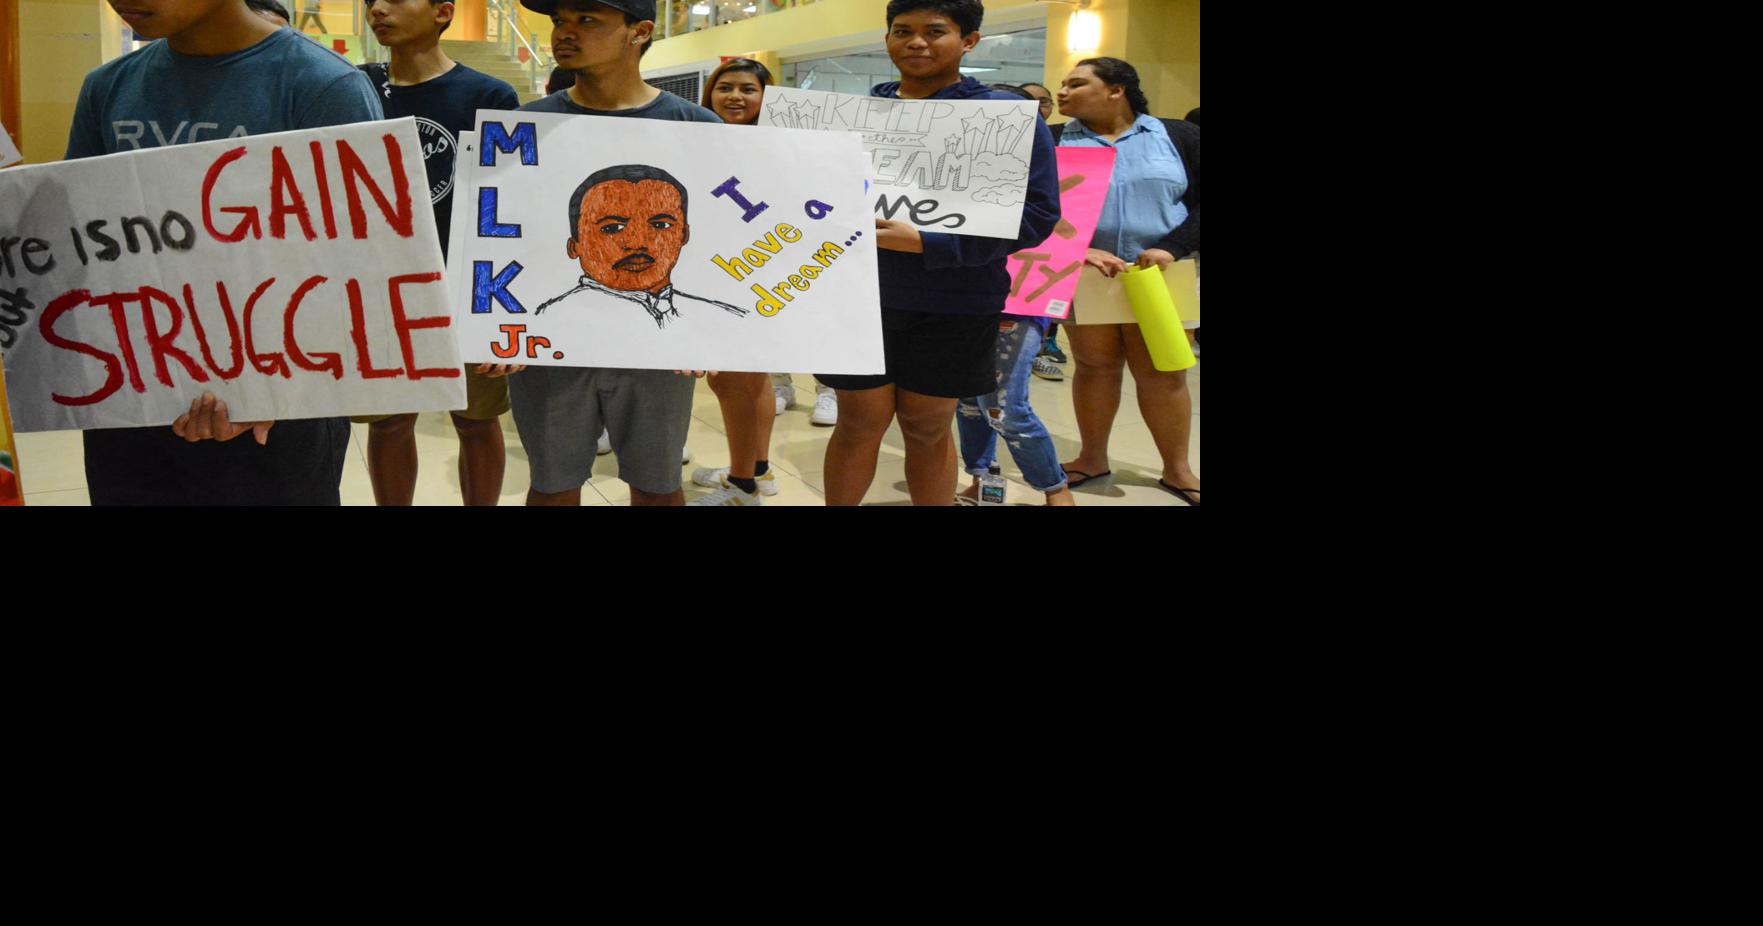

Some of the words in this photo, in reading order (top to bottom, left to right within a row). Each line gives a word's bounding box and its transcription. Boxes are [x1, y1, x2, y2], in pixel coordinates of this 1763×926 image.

[822, 93, 955, 133] KEEP
[201, 133, 414, 244] GAIN
[872, 148, 972, 191] EAM
[710, 175, 770, 223] I
[710, 222, 803, 281] have
[804, 199, 834, 220] a
[39, 271, 461, 406] STRUGGLE
[490, 323, 565, 359] Jr.
